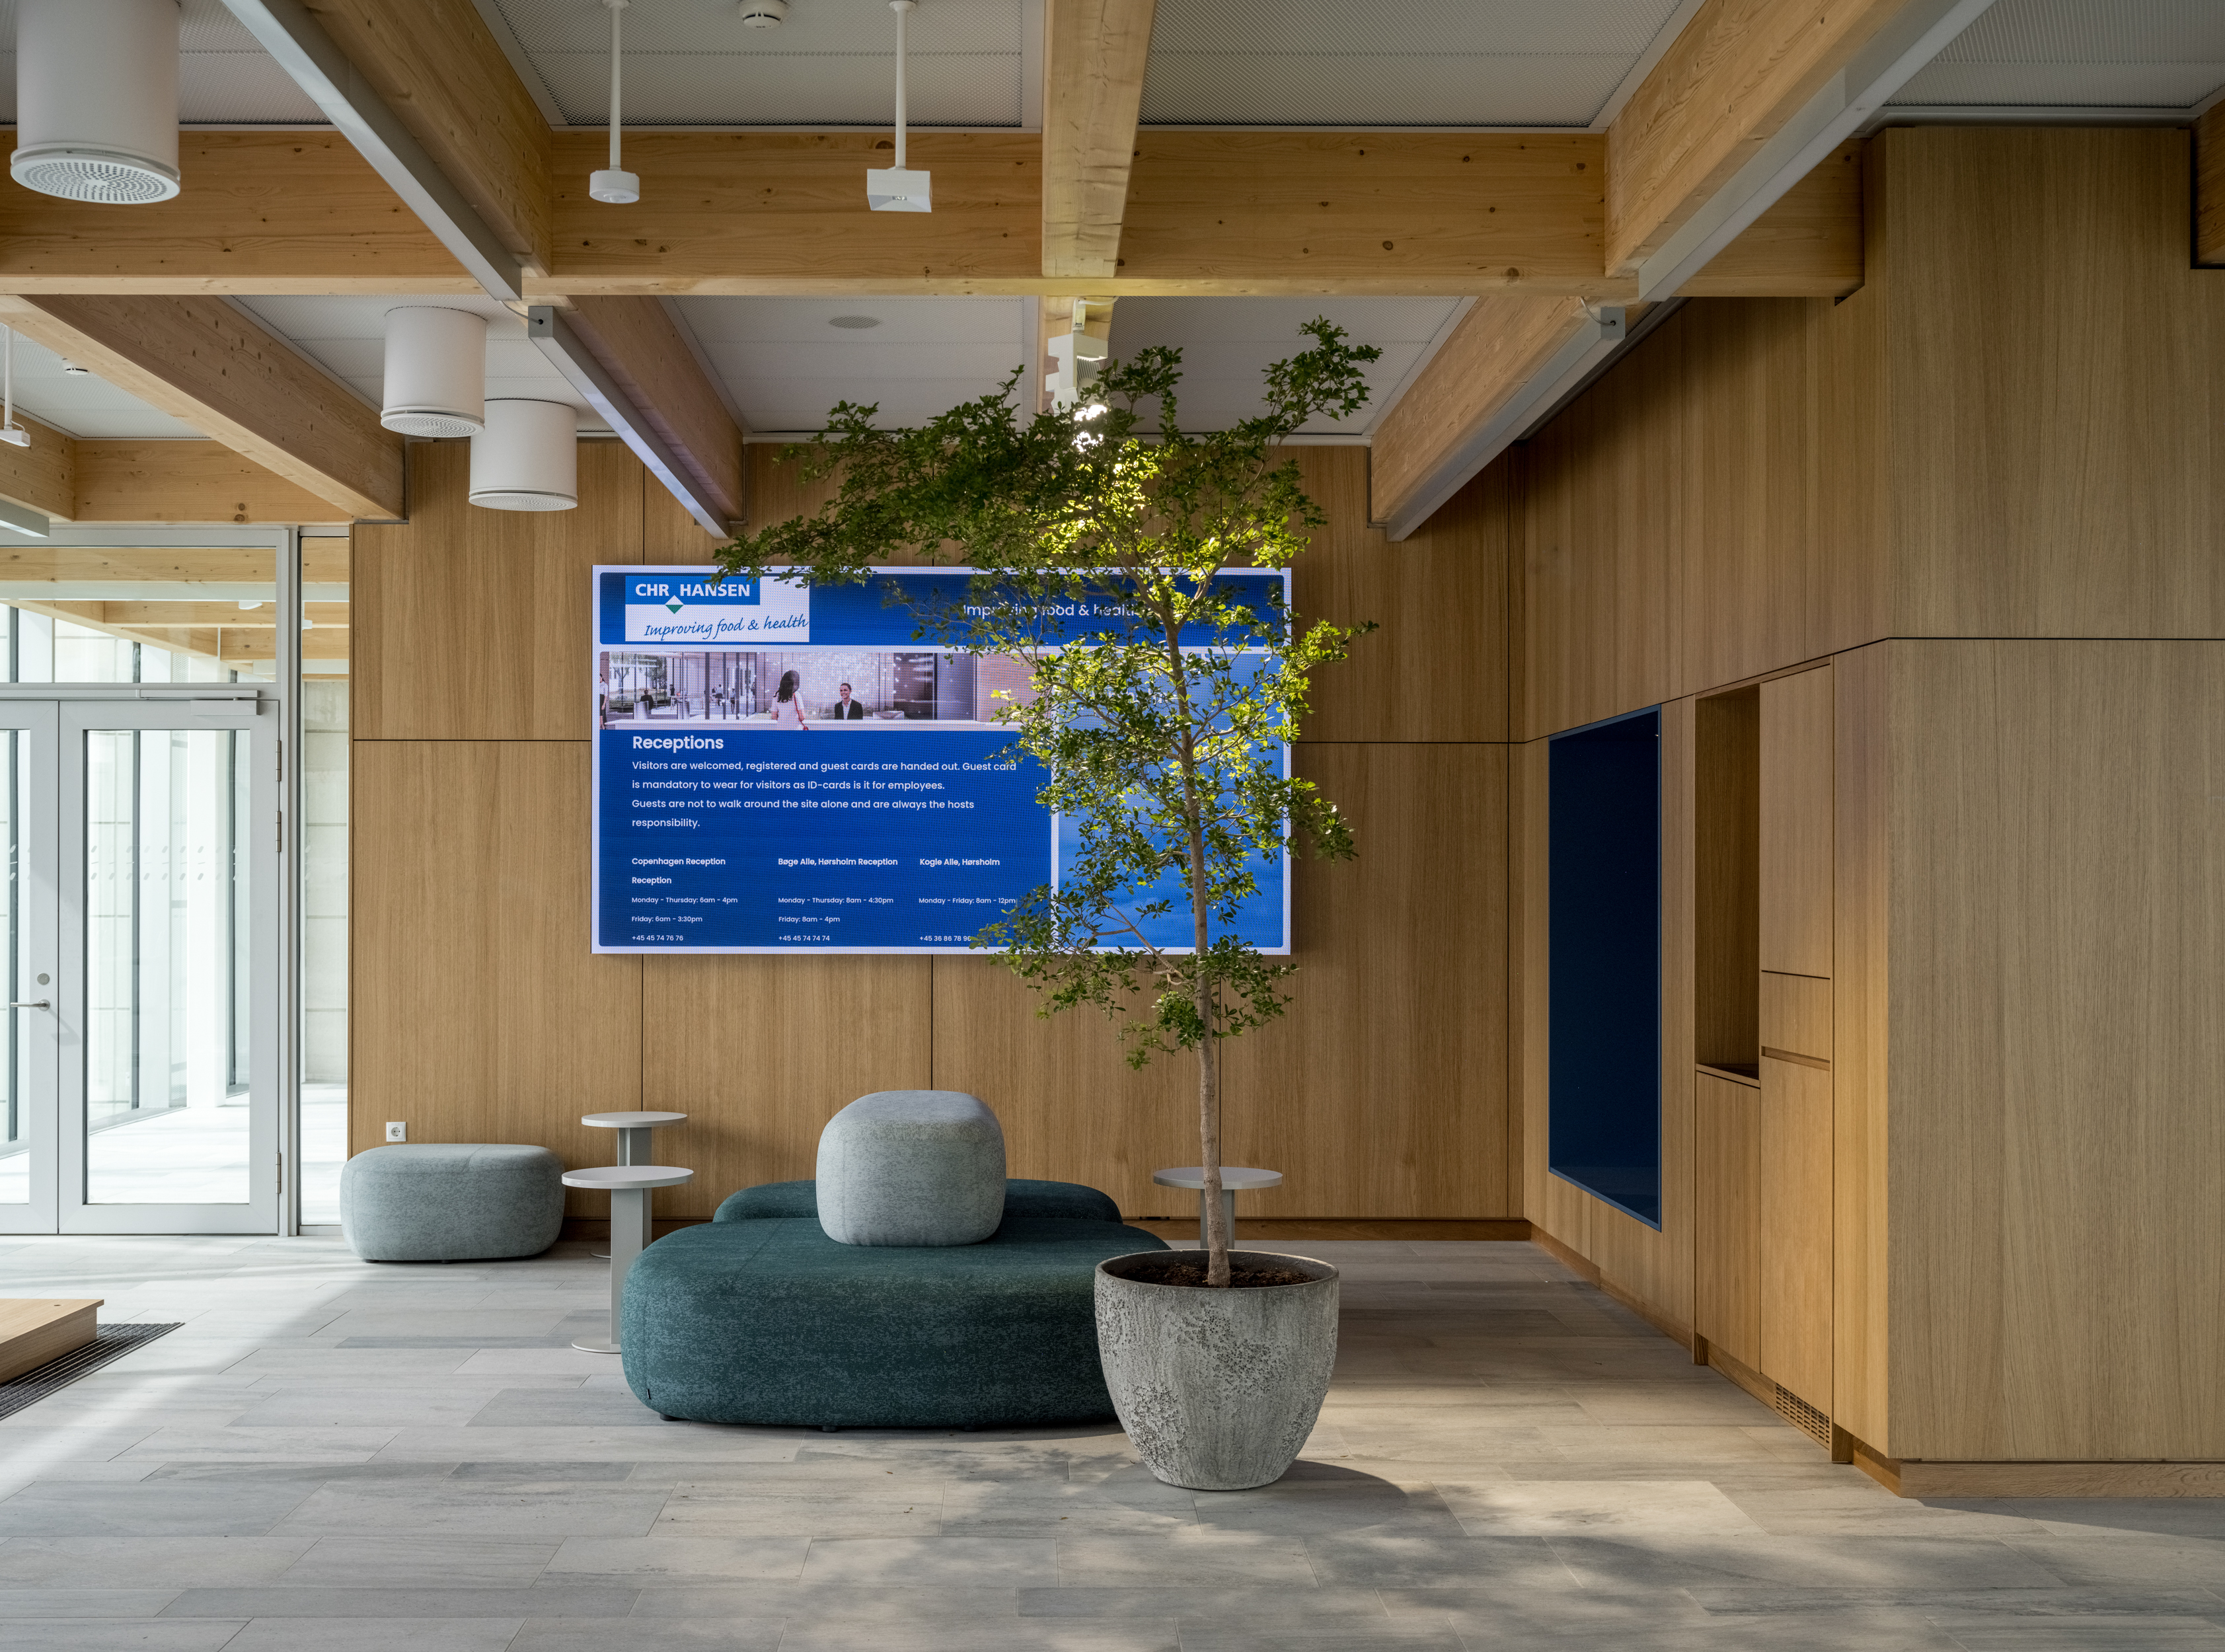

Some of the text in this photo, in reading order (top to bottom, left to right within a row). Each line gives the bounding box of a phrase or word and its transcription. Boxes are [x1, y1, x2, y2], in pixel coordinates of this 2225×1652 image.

[635, 583, 751, 597] CHR HANSEN
[1078, 604, 1090, 616] &
[644, 613, 810, 641] Improving food & health
[632, 735, 724, 753] Receptions
[632, 761, 668, 770] Visitors
[689, 761, 744, 772] welcomed,
[746, 761, 796, 772] registered
[798, 761, 819, 770] and
[821, 763, 849, 772] guest
[850, 761, 879, 770] cards
[901, 761, 939, 770] handed
[941, 762, 960, 770] out.
[962, 762, 991, 770] Guest
[993, 762, 1016, 770] card
[632, 780, 640, 789] is
[642, 780, 698, 791] mandatory
[740, 780, 753, 789] for
[756, 780, 791, 789] visitors
[808, 780, 851, 790] ID-cards
[864, 781, 870, 790] it
[872, 780, 886, 790] for
[887, 780, 945, 792] employees.
[632, 800, 666, 808] Guests
[718, 800, 741, 808] walk
[743, 800, 780, 808] around
[782, 800, 798, 808] the
[801, 800, 819, 808] site
[821, 800, 849, 808] alone
[850, 800, 871, 808] and
[891, 800, 927, 811] always
[929, 800, 945, 809] the
[948, 800, 974, 809] hosts
[632, 818, 700, 829] responsibility.
[632, 858, 726, 867] Copenhagen Reception
[778, 858, 799, 868] Bøge
[800, 858, 817, 866] Alle,
[858, 858, 898, 868] Reception
[919, 858, 942, 868] Kogle
[944, 858, 961, 867] Alle,
[632, 876, 672, 886] Reception
